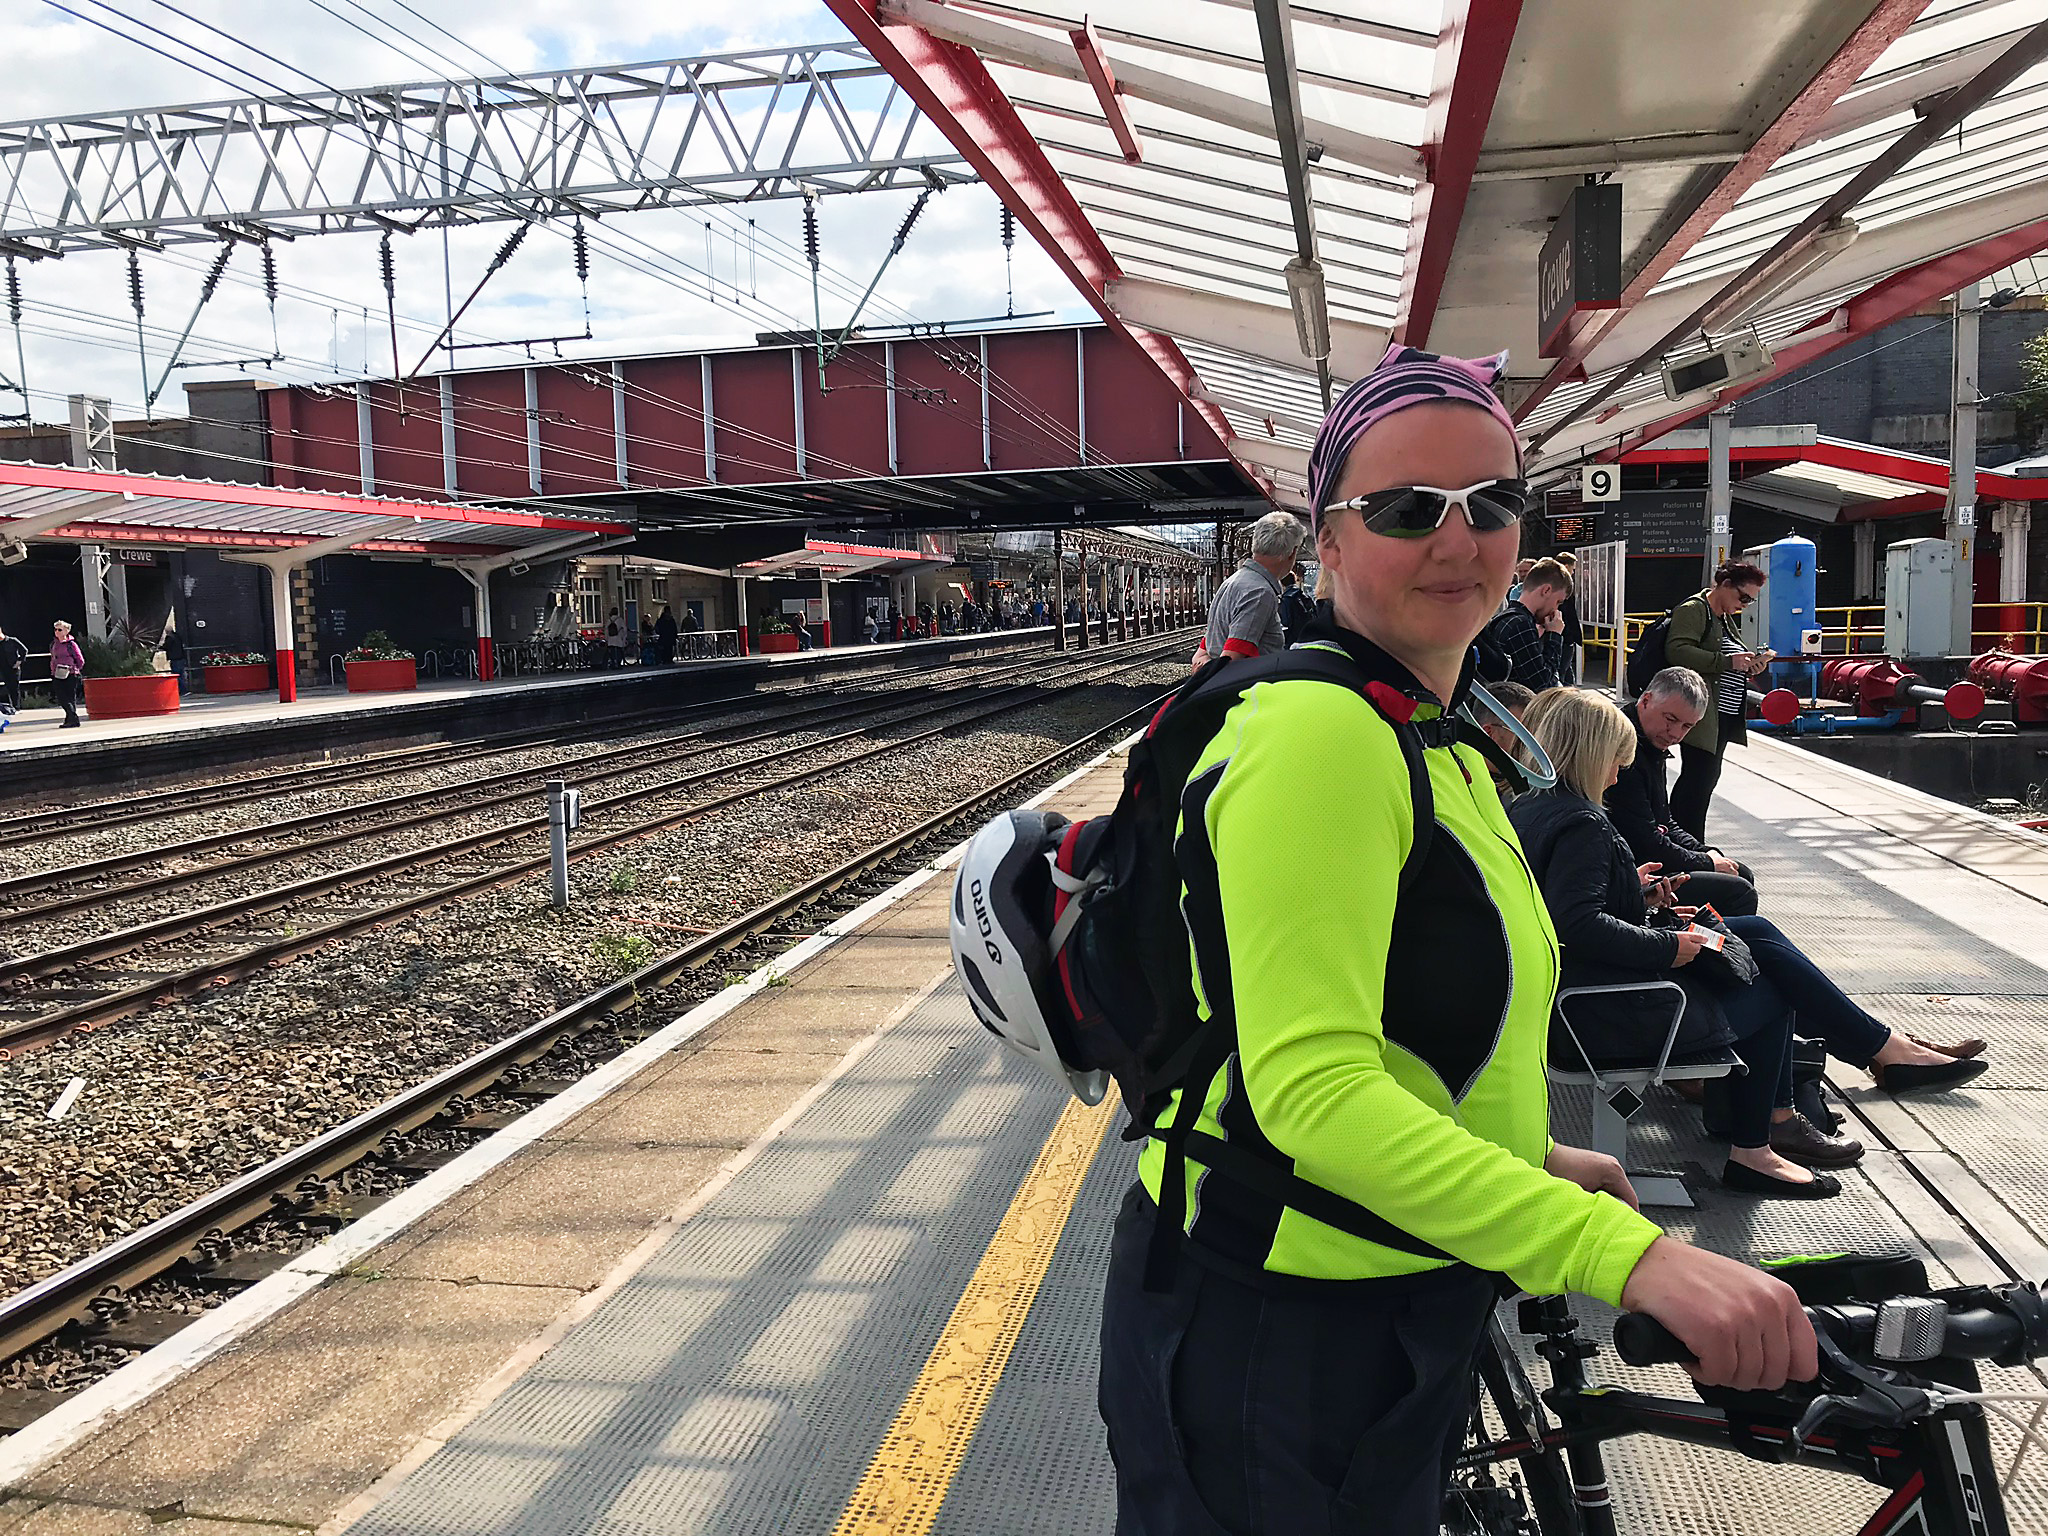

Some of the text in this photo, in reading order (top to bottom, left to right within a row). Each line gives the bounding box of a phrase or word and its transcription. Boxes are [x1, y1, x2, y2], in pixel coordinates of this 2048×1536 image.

[1542, 240, 1570, 322] Crewe
[1590, 470, 1612, 497] 9
[119, 549, 152, 561] Crewe
[971, 879, 992, 938] GIRO
